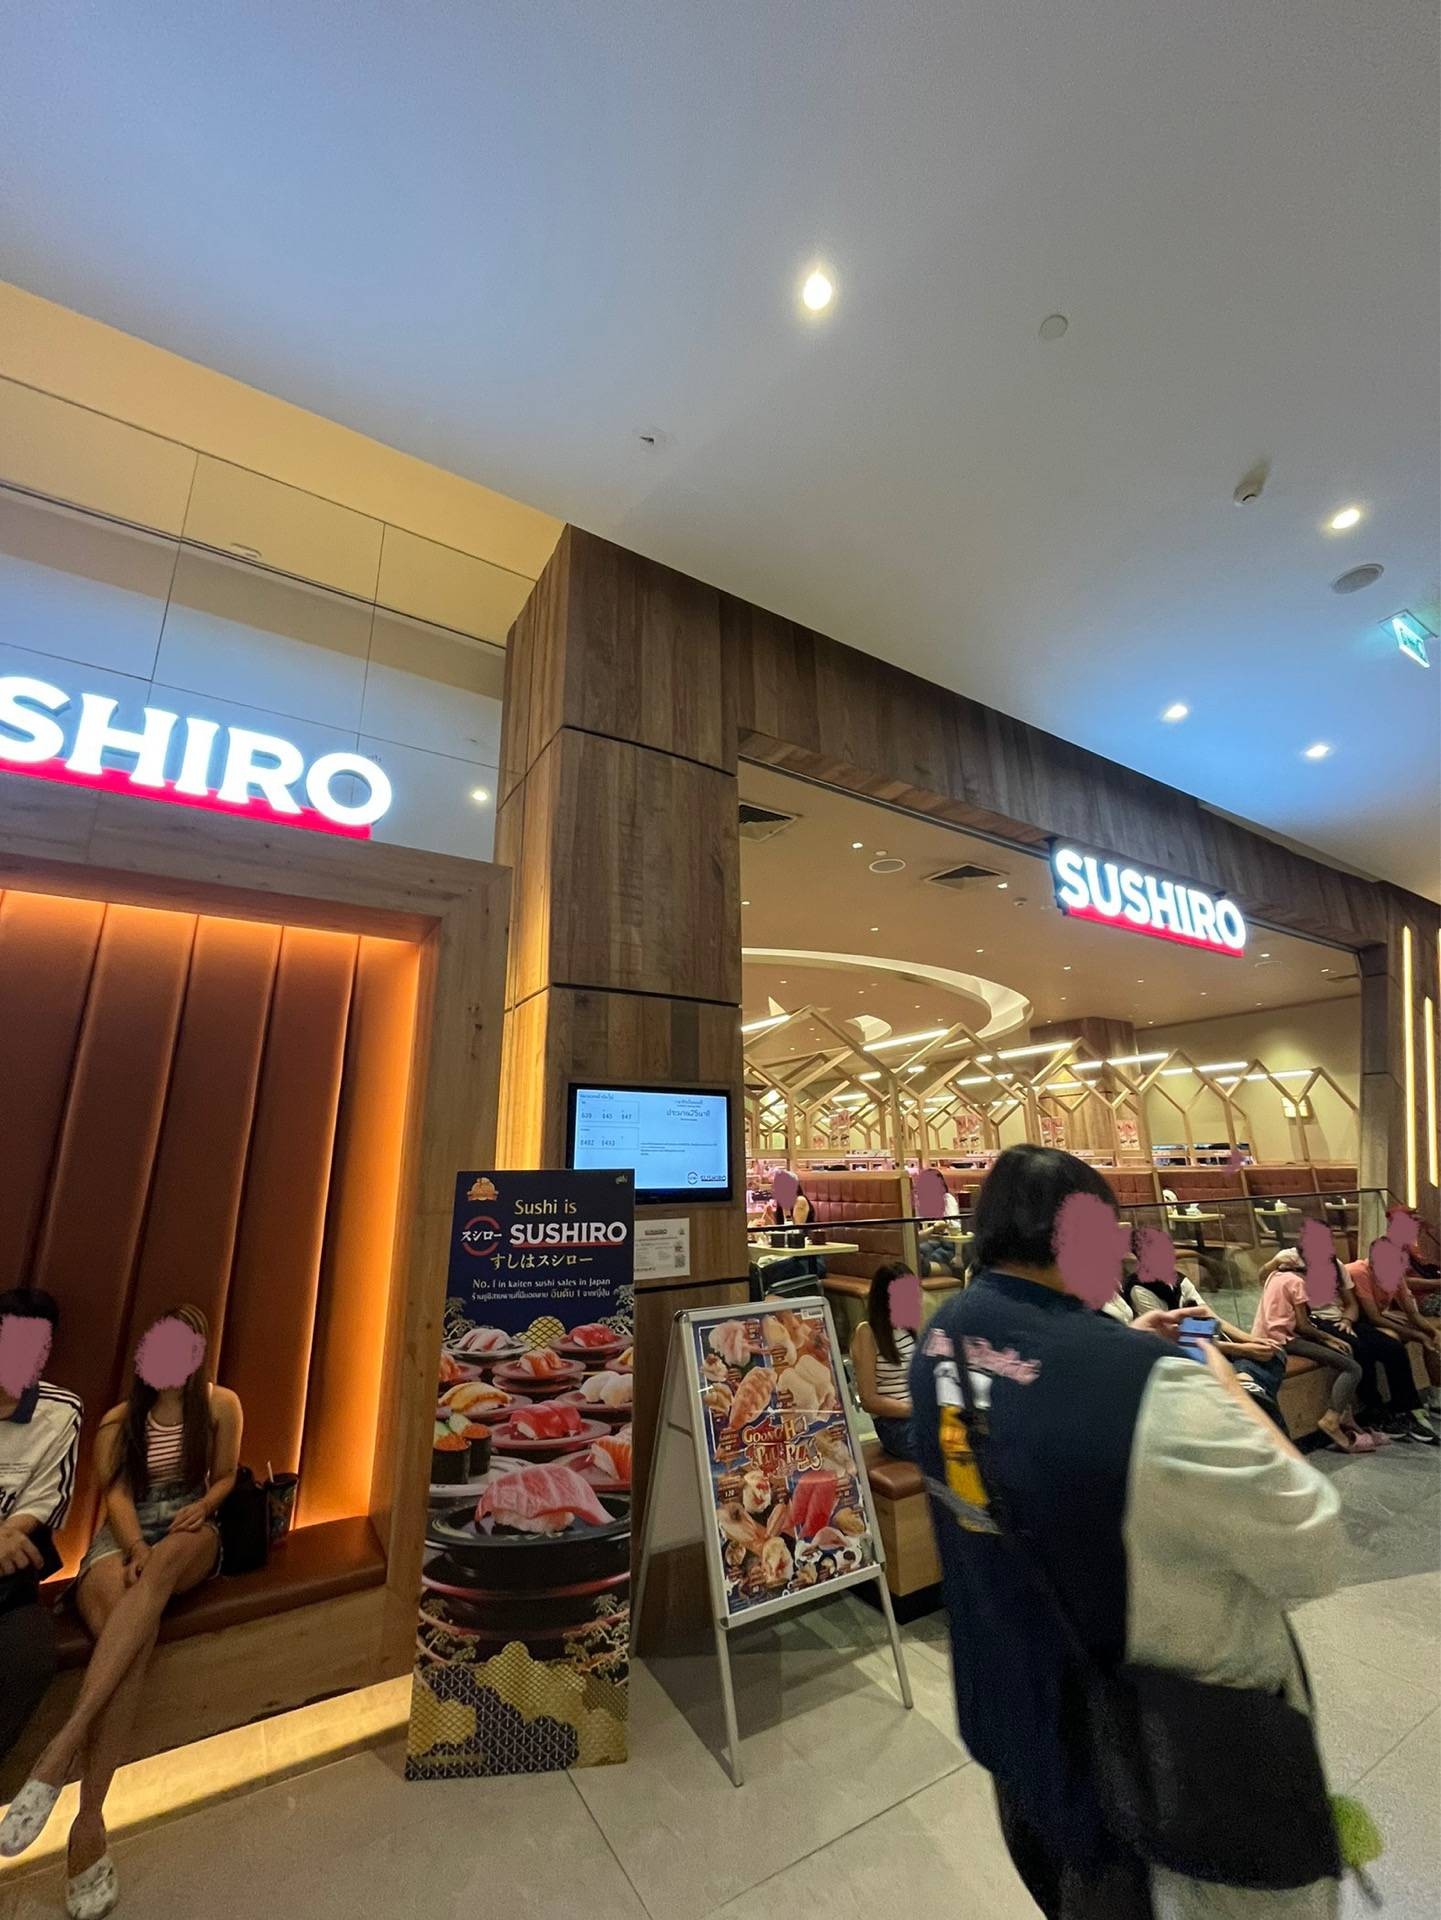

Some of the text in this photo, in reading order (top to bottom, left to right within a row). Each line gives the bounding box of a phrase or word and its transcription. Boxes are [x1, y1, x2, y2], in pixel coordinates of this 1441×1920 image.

[1055, 849, 1247, 949] SUSHIRO
[514, 1198, 577, 1216] Sushi is
[461, 1231, 502, 1242] スシロー
[510, 1222, 627, 1244] SUSHIRO
[491, 1253, 593, 1270] すしはスシロー
[472, 1278, 490, 1289] No.
[498, 1279, 506, 1288] in
[508, 1278, 533, 1288] kaiten
[535, 1278, 555, 1287] sushi
[557, 1278, 577, 1287] sales
[579, 1277, 587, 1286] in
[589, 1277, 611, 1287] Japan
